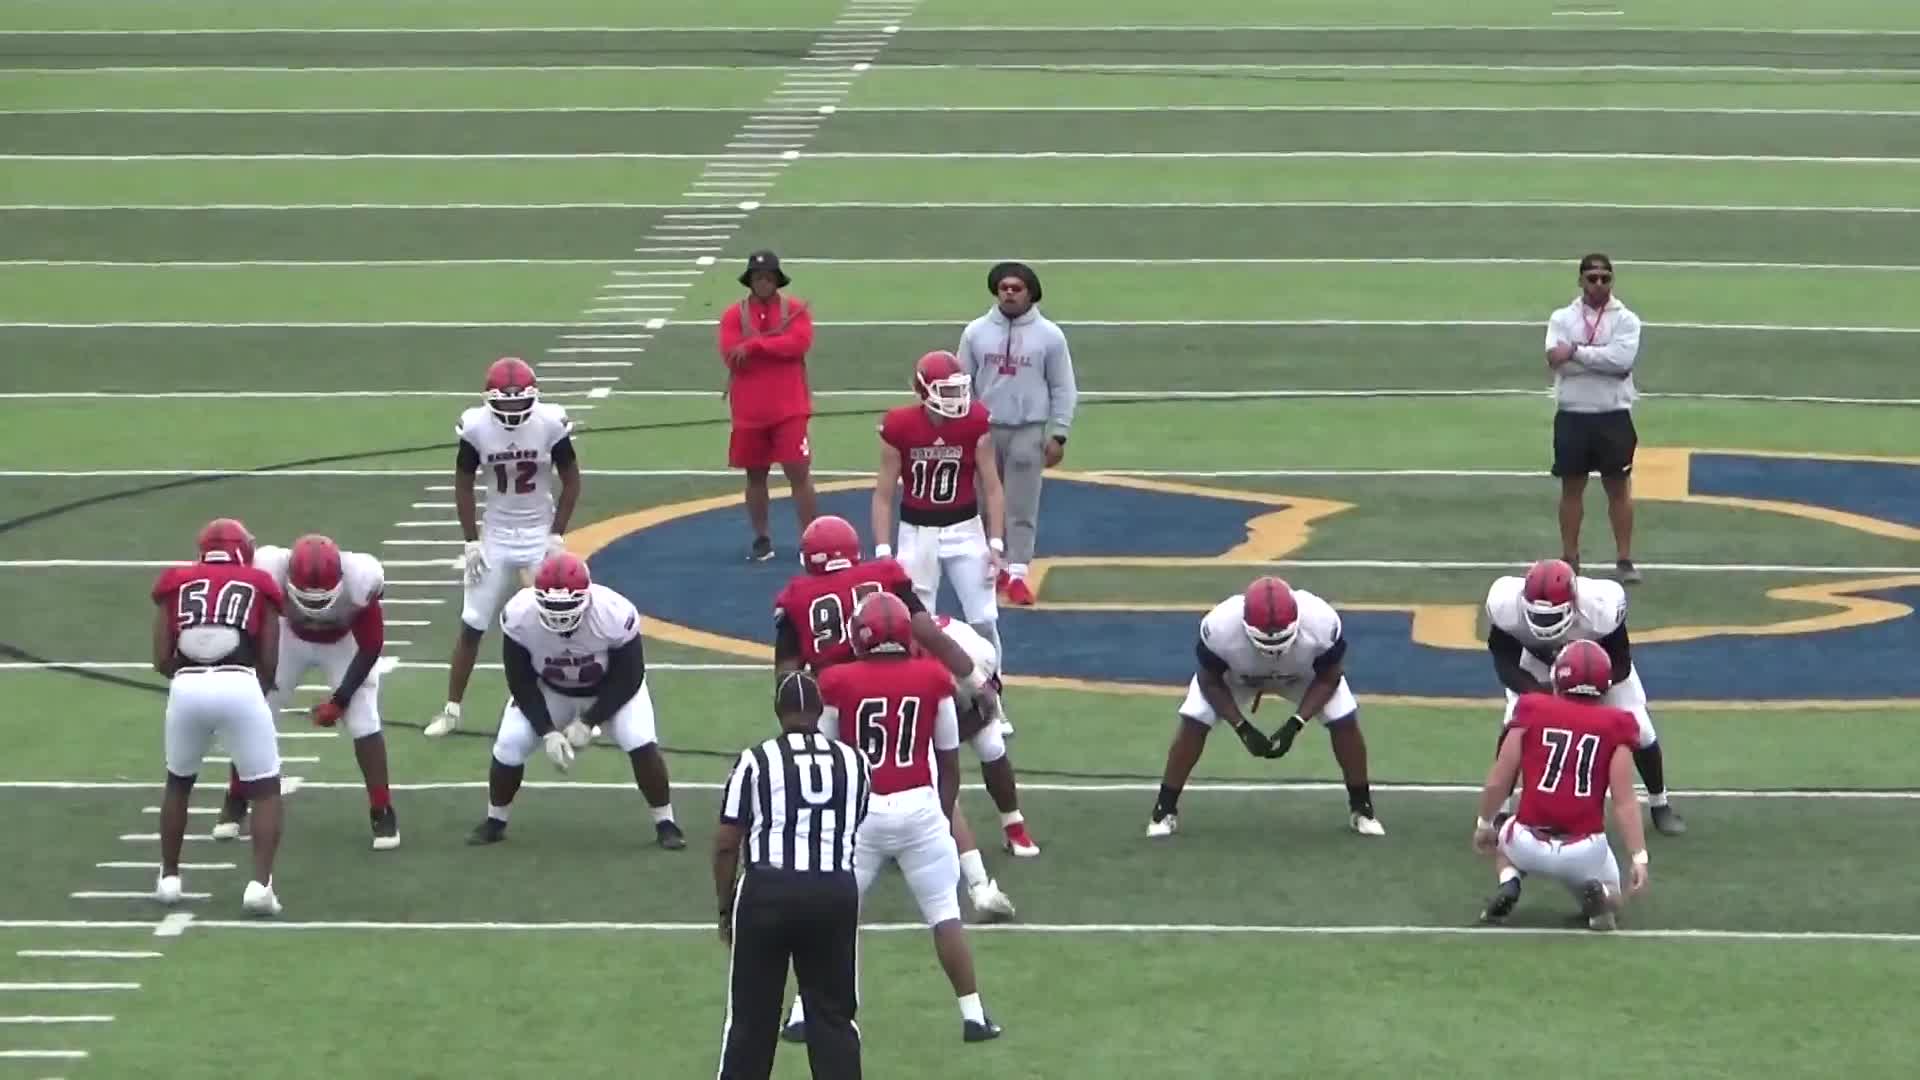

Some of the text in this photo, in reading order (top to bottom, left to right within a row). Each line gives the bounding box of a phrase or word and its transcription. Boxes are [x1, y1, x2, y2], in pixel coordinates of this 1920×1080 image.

[493, 461, 539, 495] 12
[911, 459, 960, 504] 10
[178, 578, 255, 630] 50
[855, 696, 920, 769] 61
[793, 754, 834, 804] U
[1537, 727, 1600, 797] 71
